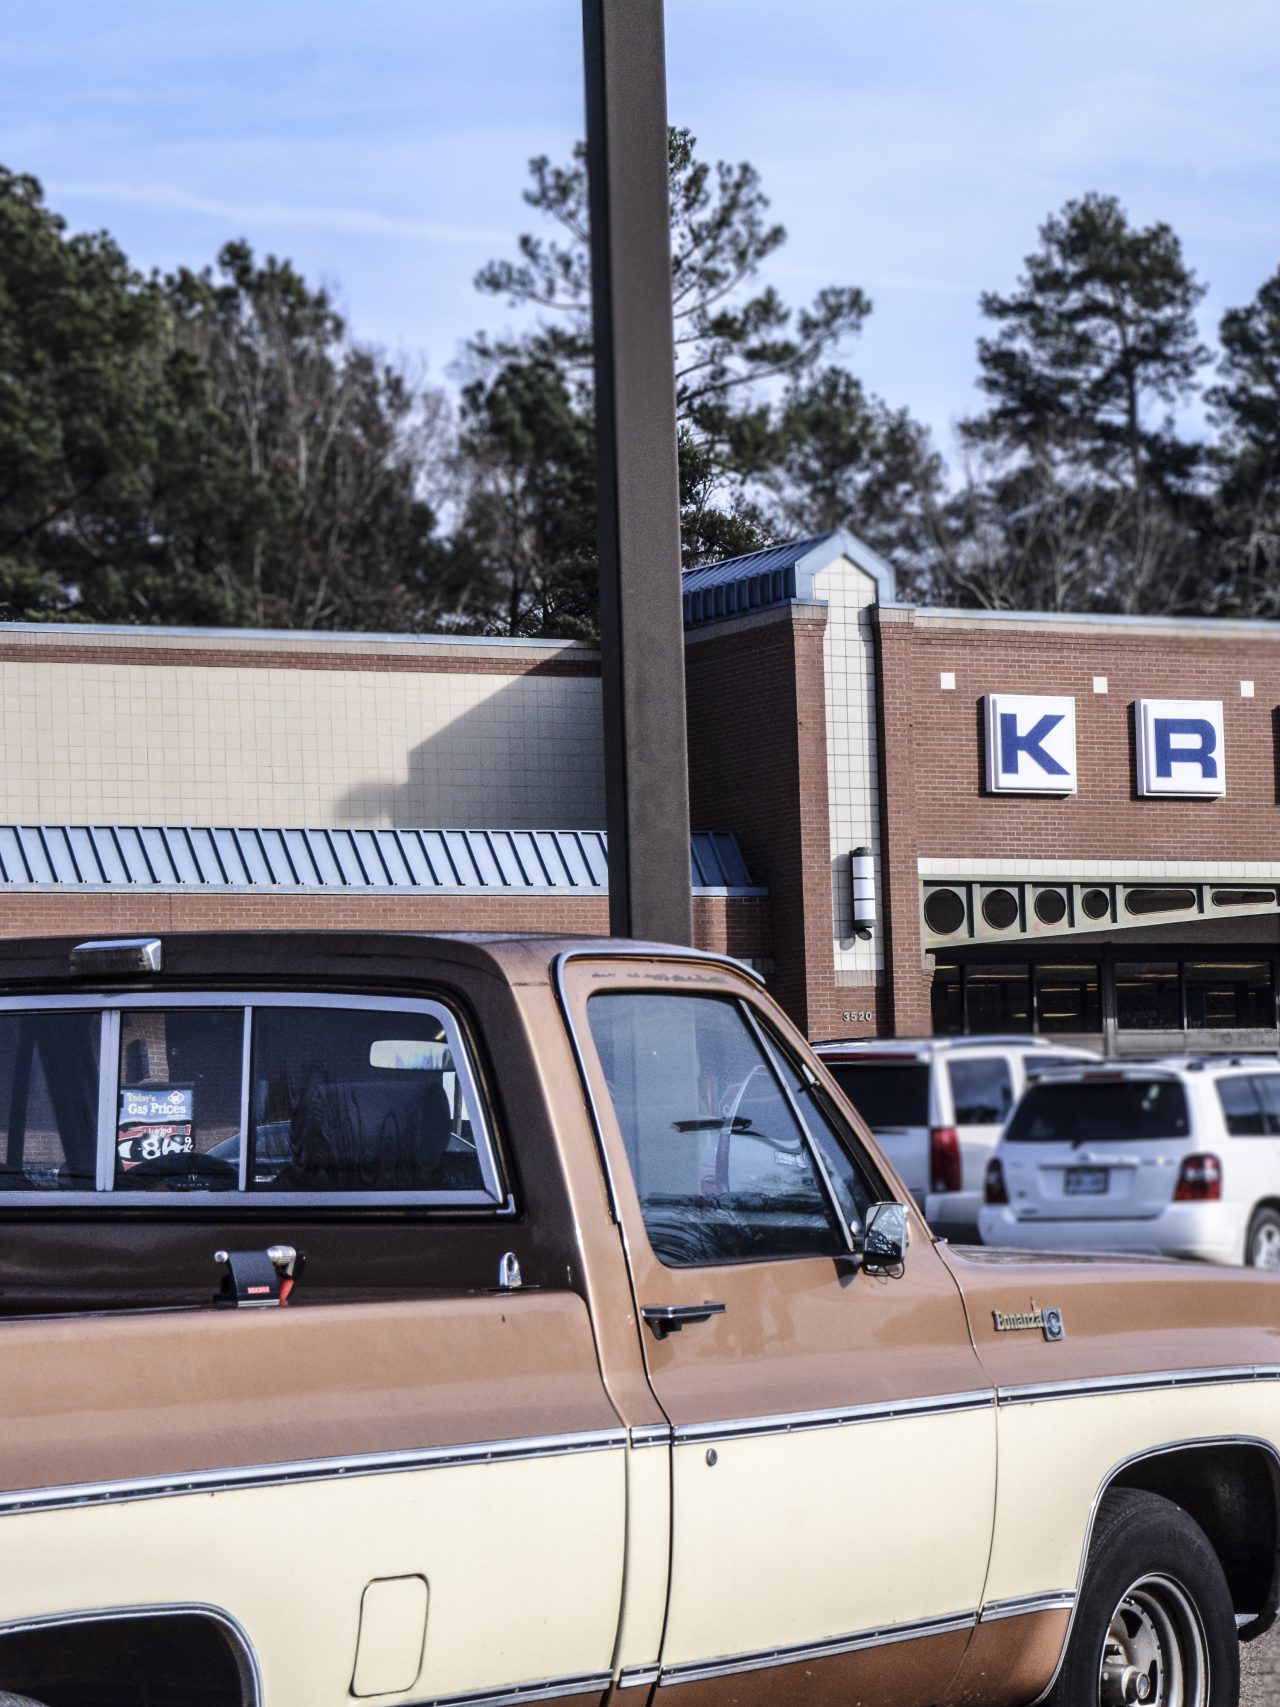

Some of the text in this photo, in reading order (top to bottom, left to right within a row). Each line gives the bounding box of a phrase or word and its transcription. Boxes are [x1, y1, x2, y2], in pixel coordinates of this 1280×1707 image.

[843, 1011, 872, 1021] 3520
[128, 1103, 187, 1115] Gas Prices
[995, 1310, 1044, 1331] Bonanza
